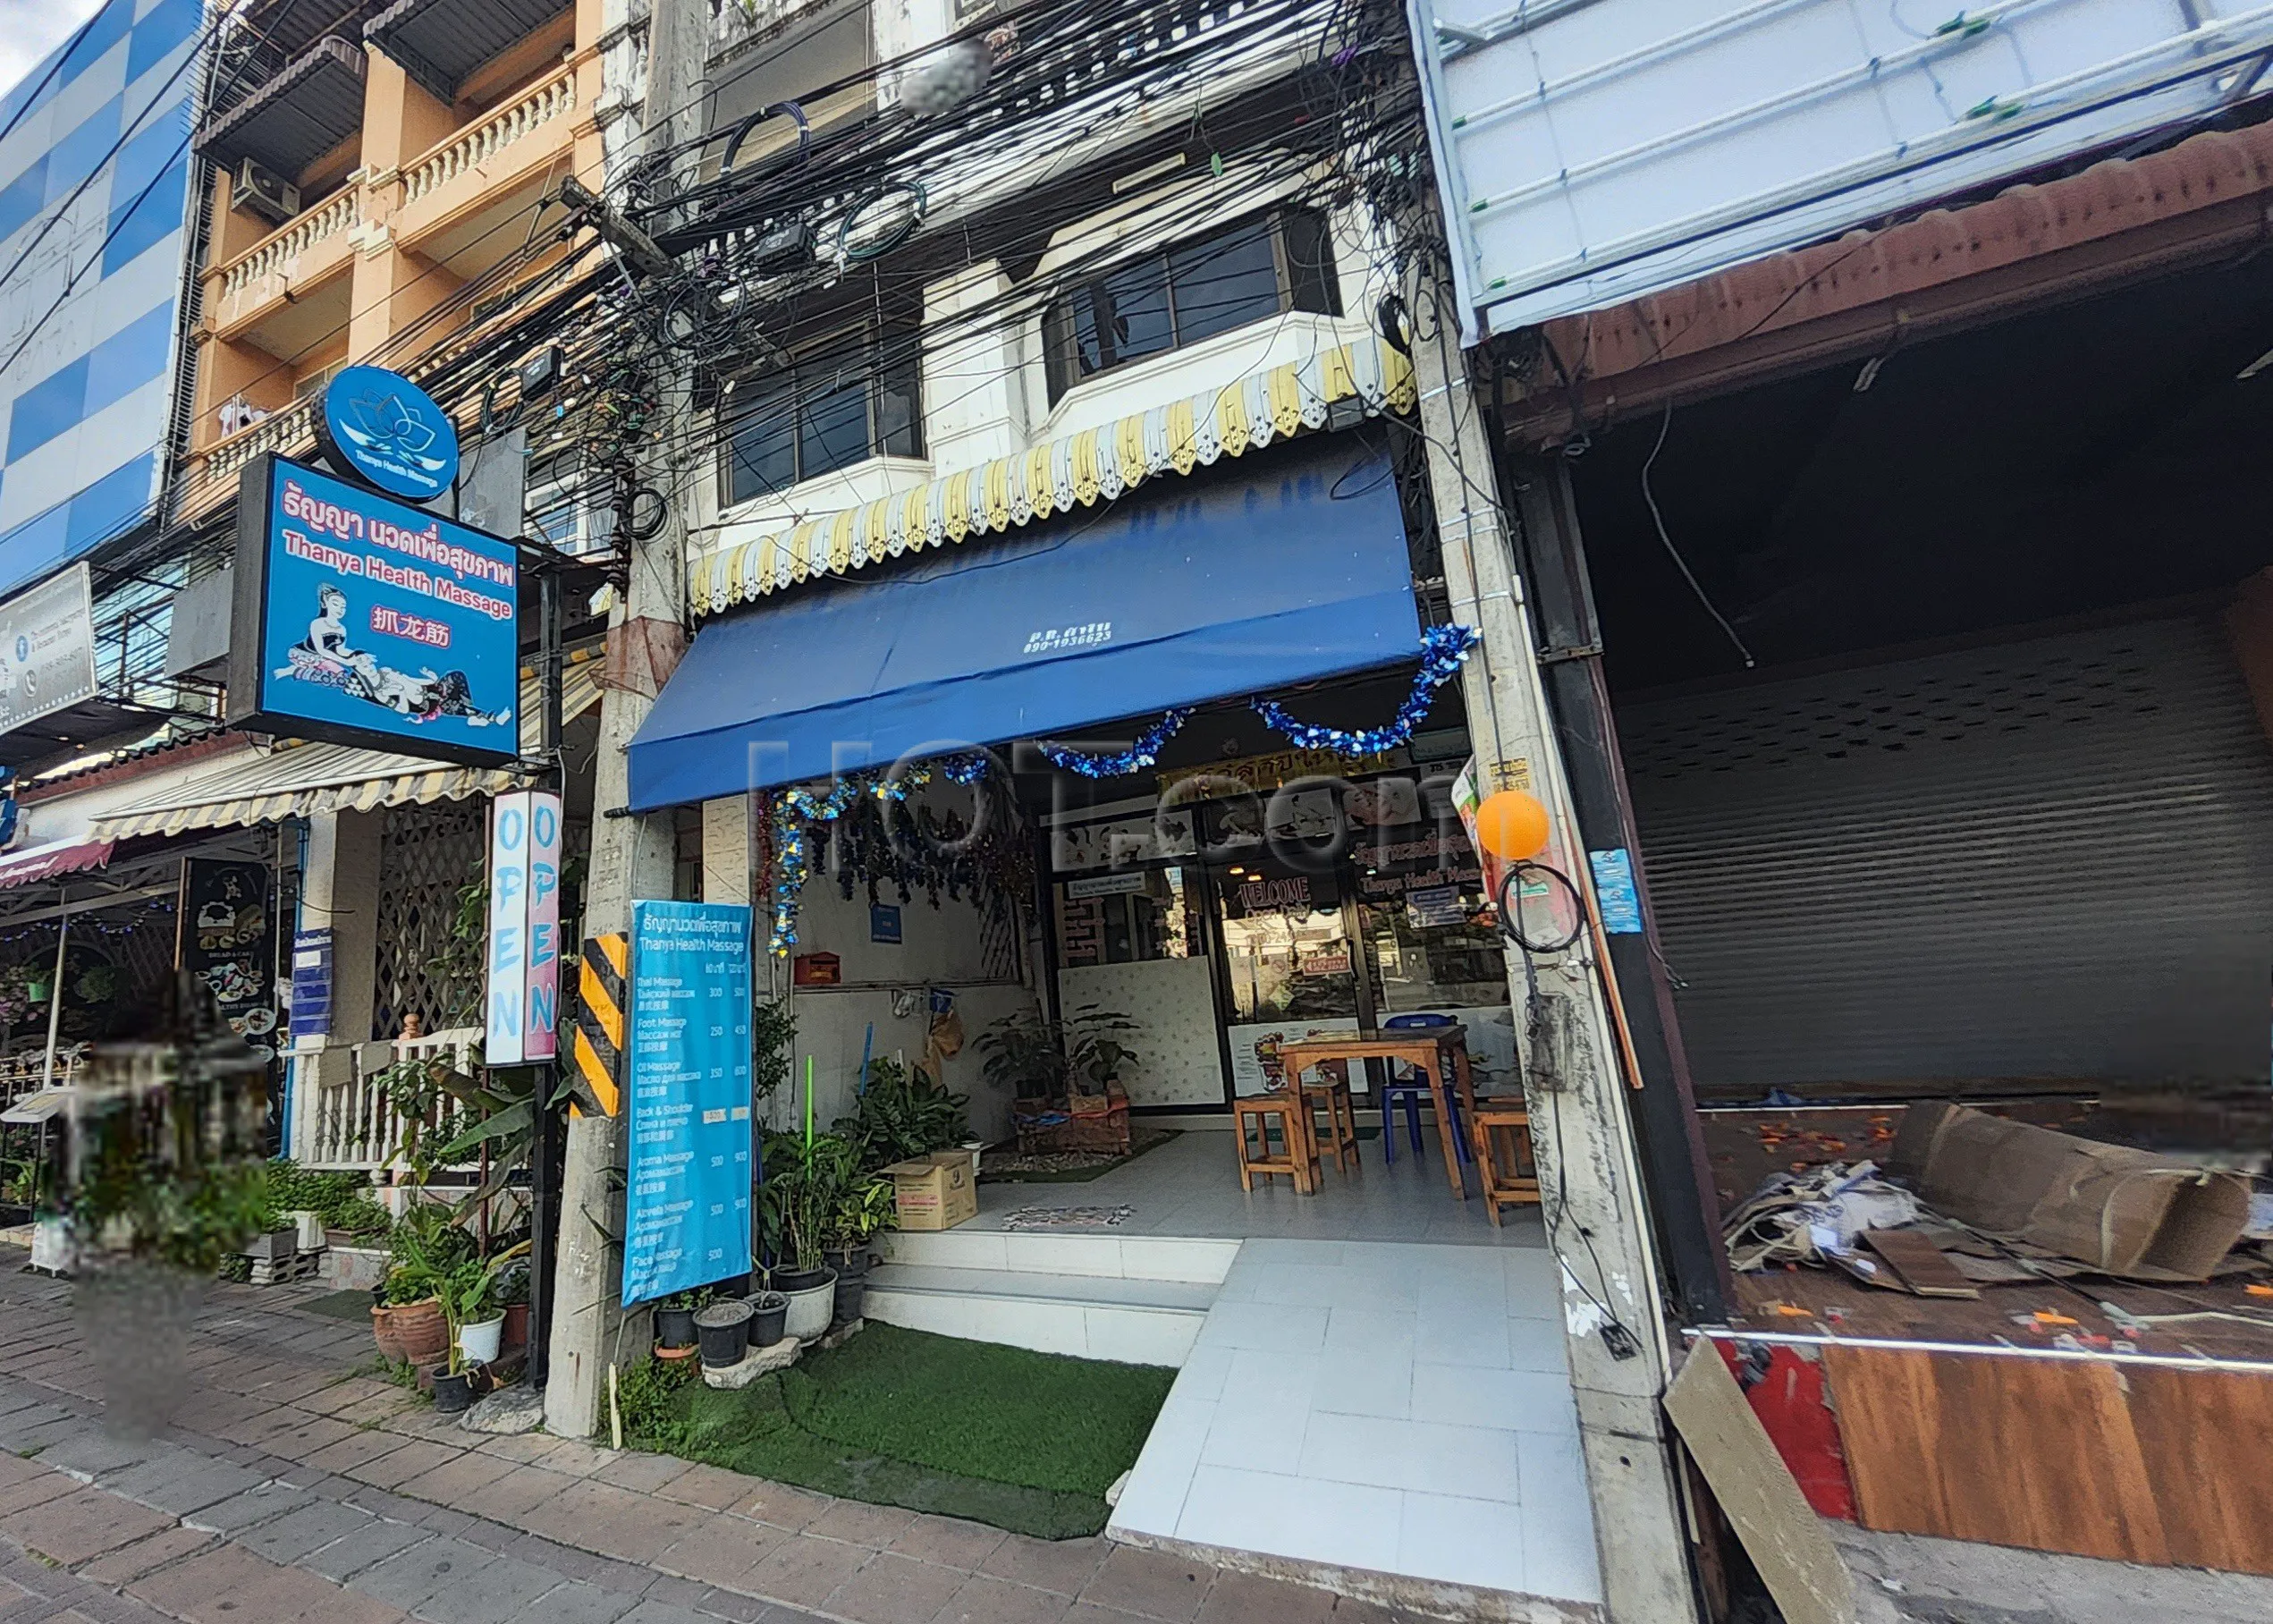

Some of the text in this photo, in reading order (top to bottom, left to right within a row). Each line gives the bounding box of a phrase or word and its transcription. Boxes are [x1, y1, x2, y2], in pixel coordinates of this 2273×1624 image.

[383, 459, 407, 477] Health
[283, 481, 514, 588] ธัญญา นวดเพื่อสุขภาพ
[283, 529, 513, 621] Thanya Health Massage
[370, 605, 452, 647] 抓龙筋
[1238, 876, 1312, 909] WELCOME
[493, 808, 523, 1037] OPEN
[531, 805, 556, 1034] OPEN
[1245, 908, 1277, 925] Open
[639, 936, 745, 956] Thanya Health Massage
[637, 1018, 656, 1028] Foot
